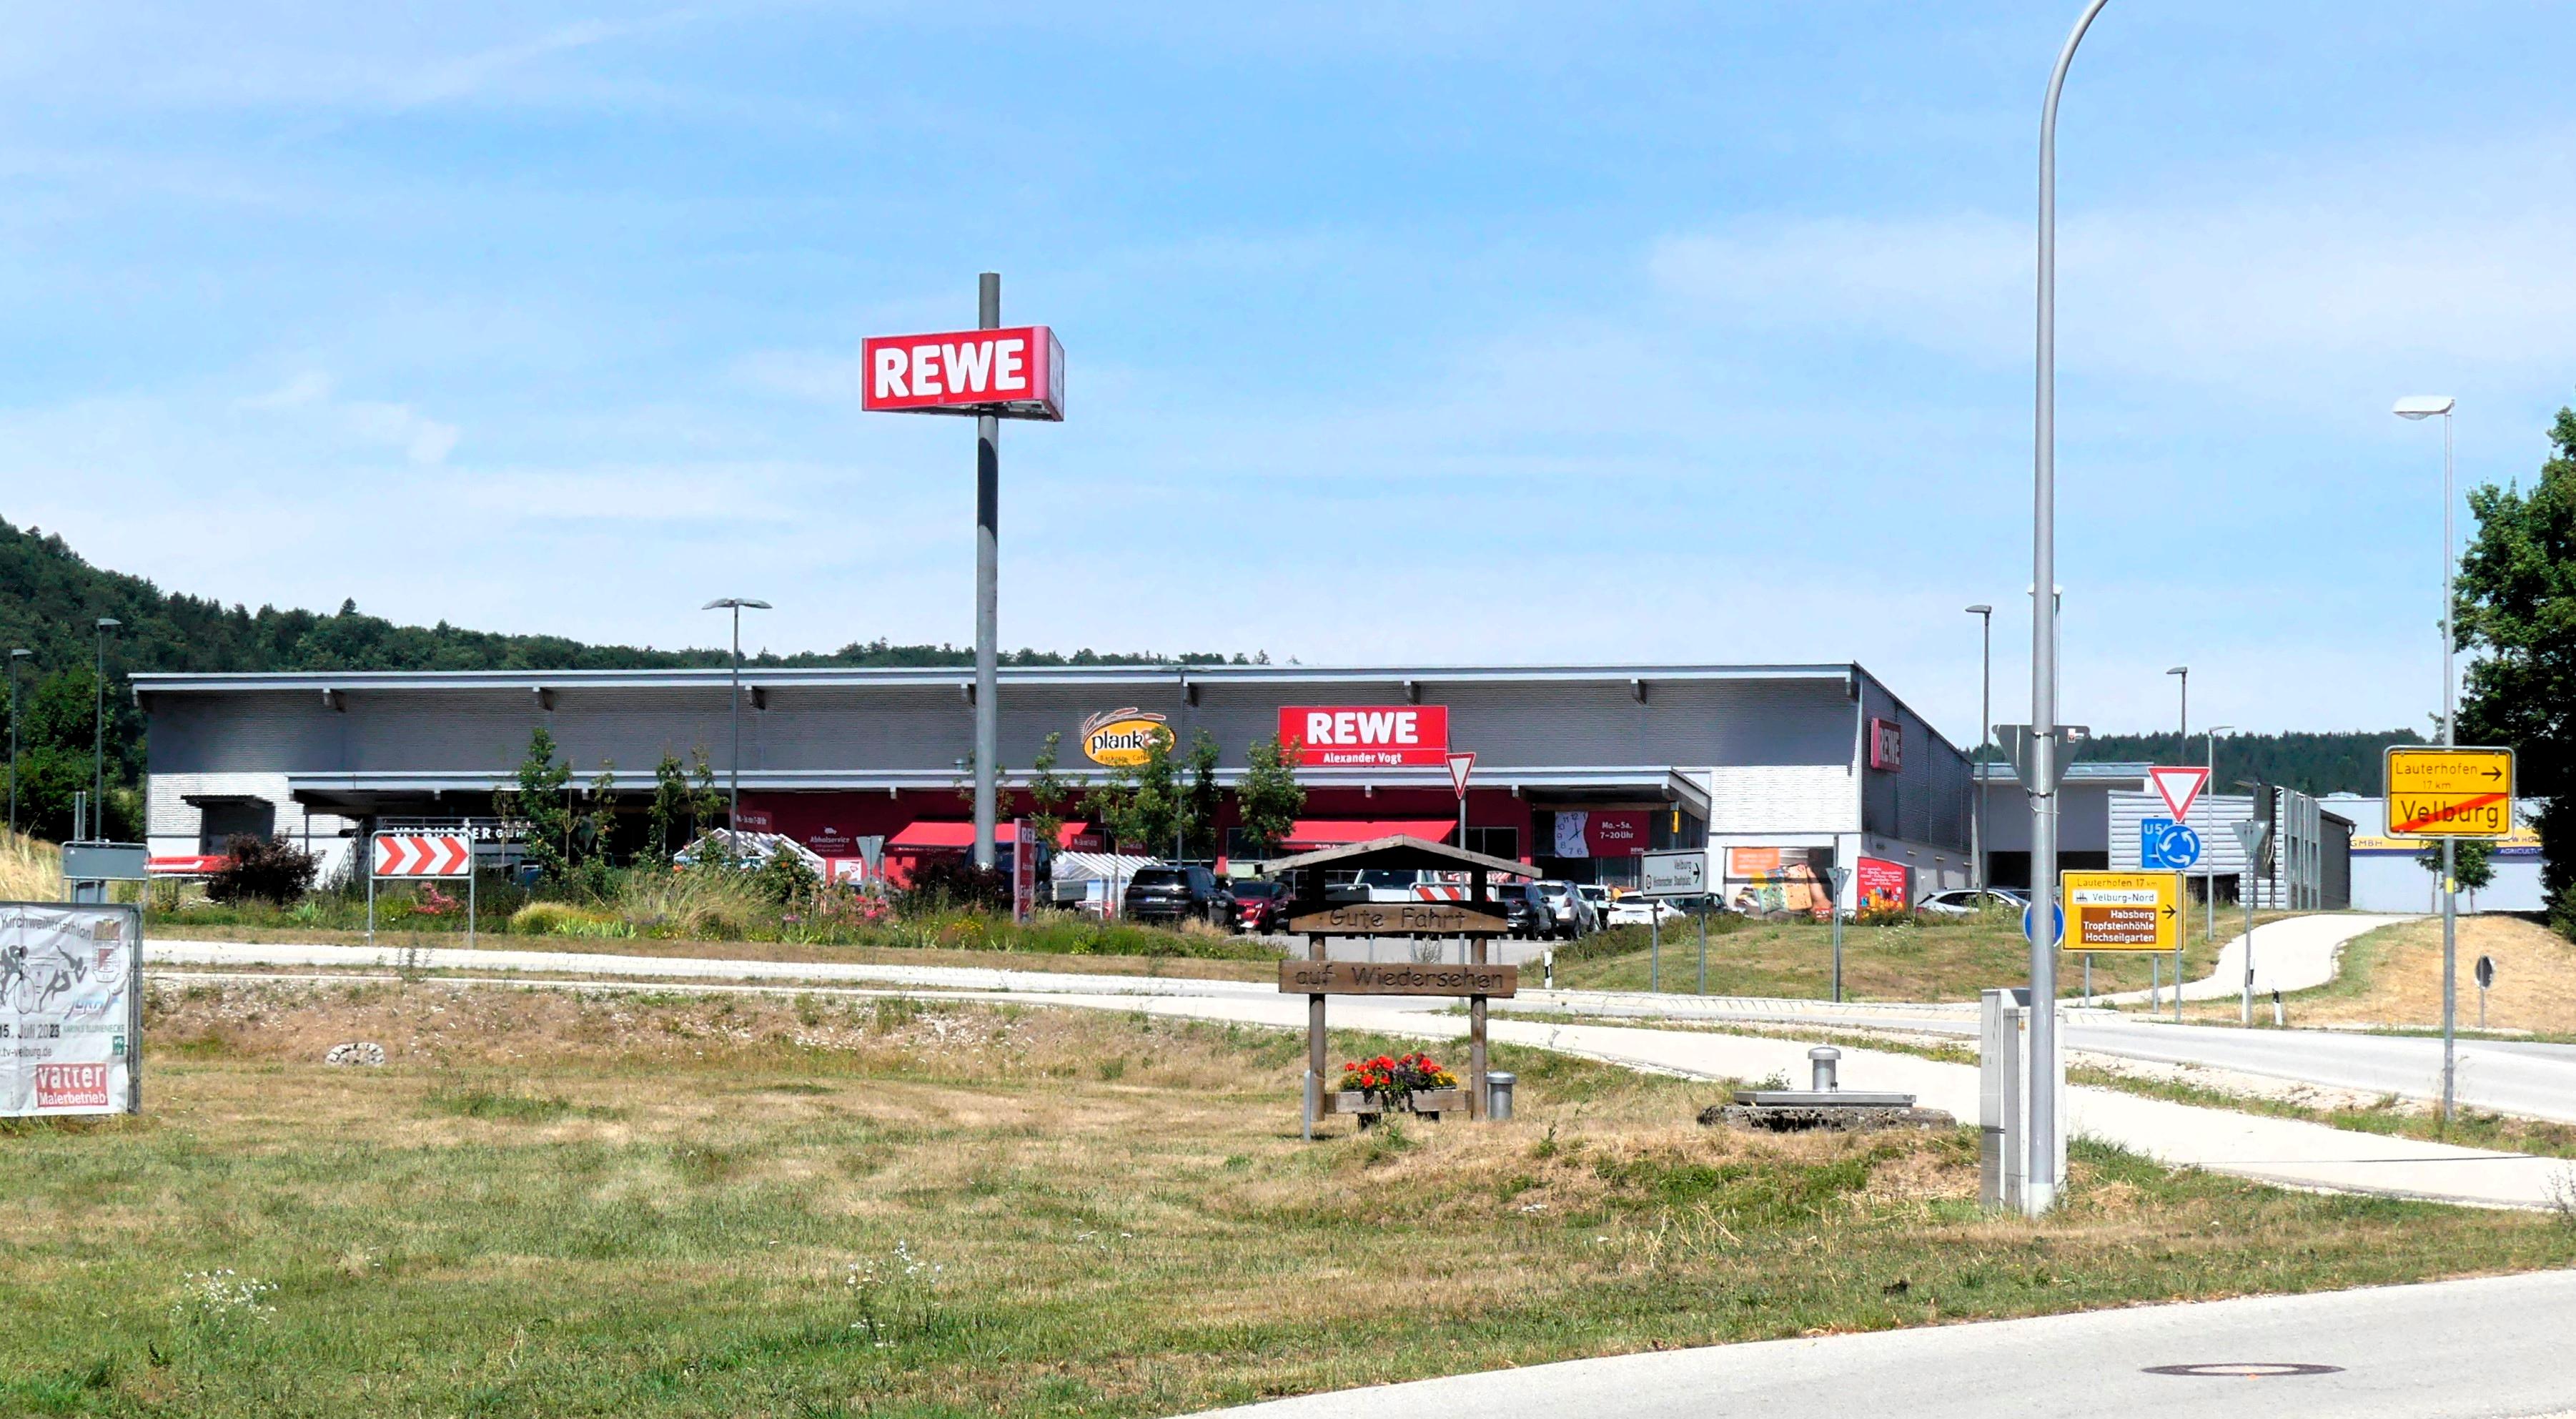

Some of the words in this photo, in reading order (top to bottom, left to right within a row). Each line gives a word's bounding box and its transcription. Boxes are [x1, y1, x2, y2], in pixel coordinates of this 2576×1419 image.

[875, 338, 1026, 399] REWE
[1307, 711, 1418, 745] REWE
[1879, 727, 1900, 765] REWE
[1323, 752, 1375, 763] Alexander
[1377, 752, 1402, 765] Vogt
[2396, 763, 2477, 775] Lauterhofen
[2423, 780, 2432, 790] 17
[2435, 780, 2452, 790] km
[2401, 800, 2498, 829] Velburg
[1674, 859, 1692, 872] Velburg
[2092, 893, 2154, 903] Velburg-Nord
[1330, 909, 1384, 928] Gute
[1402, 908, 1465, 928] Fahrt
[2110, 910, 2155, 920] Habsberg
[1, 914, 91, 940] Kirchweihtriathlon
[2084, 921, 2155, 931] Tropfsteinhöhle
[2085, 932, 2155, 944] Hochseilgarten
[1295, 965, 1334, 986] auf
[1352, 966, 1503, 989] Wiedersehen
[18, 1024, 35, 1039] Juli
[38, 1024, 59, 1039] 2023
[0, 1046, 51, 1059] .tv-velburg.de
[39, 1067, 104, 1089] vatter
[39, 1092, 106, 1105] Malerbetrieb
